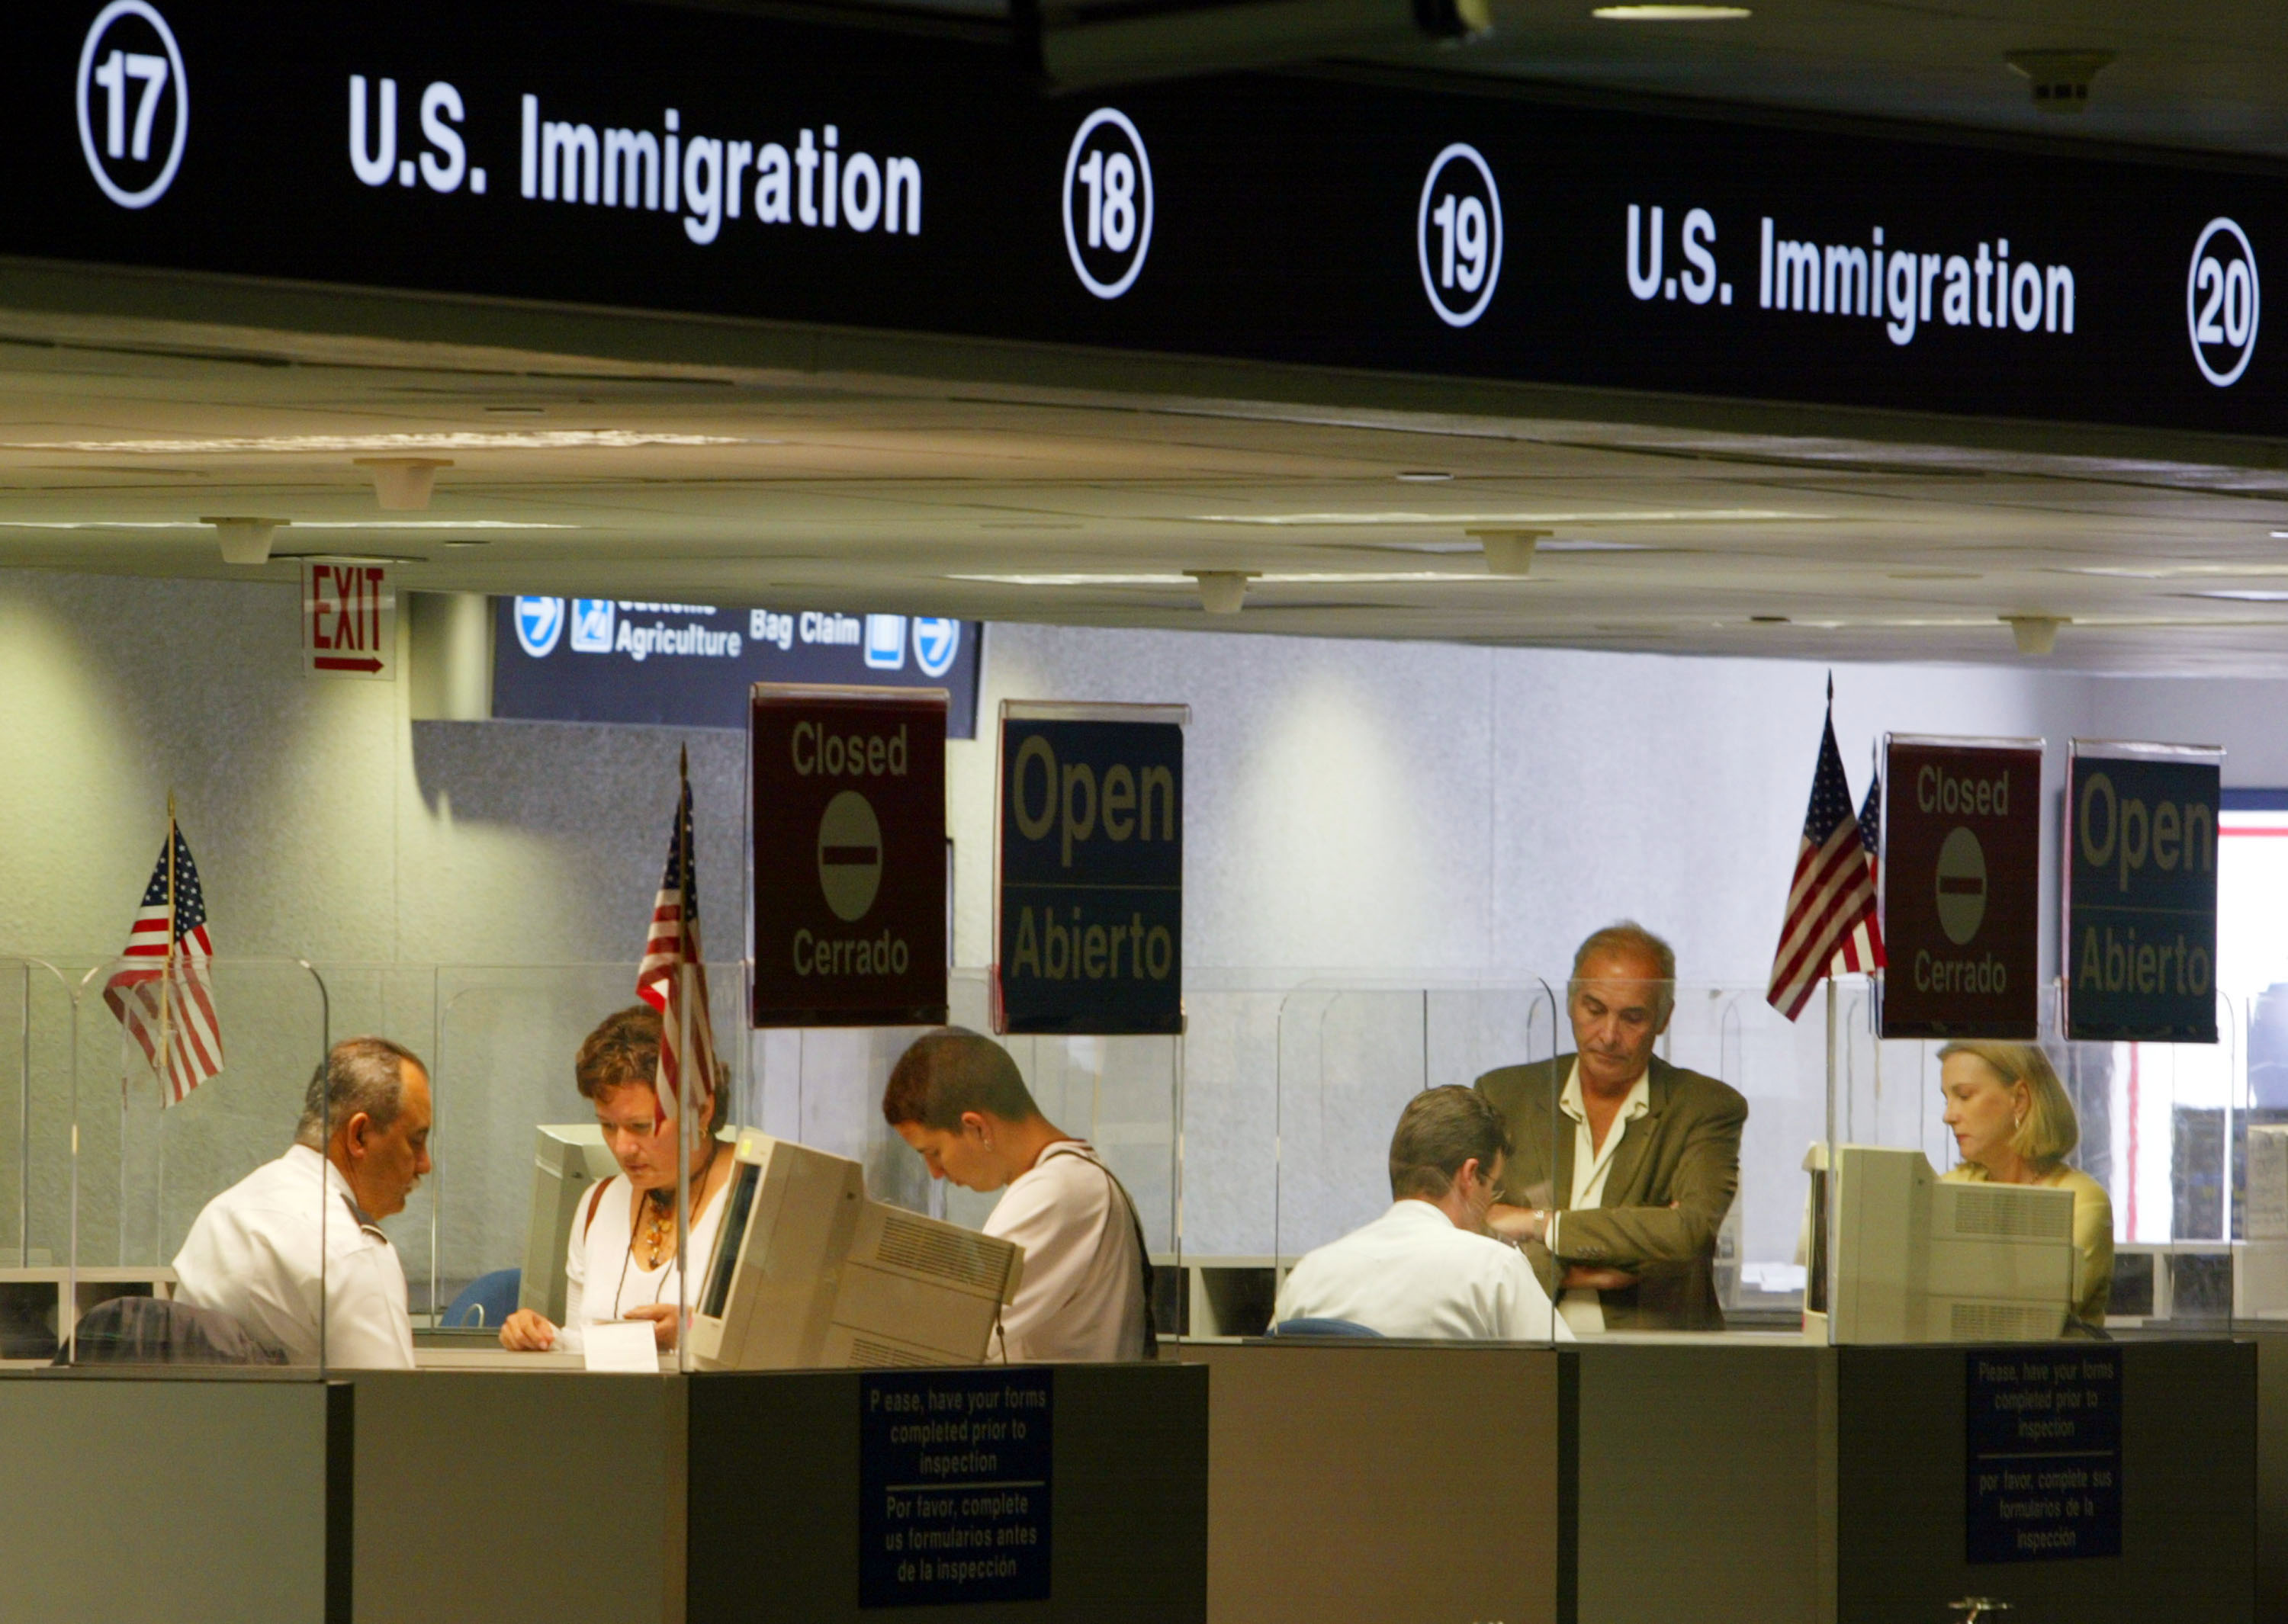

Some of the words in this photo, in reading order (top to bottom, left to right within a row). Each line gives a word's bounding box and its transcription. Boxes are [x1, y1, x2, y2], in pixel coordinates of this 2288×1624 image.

[95, 50, 168, 161] 17
[349, 74, 487, 195] U.S.
[520, 93, 921, 245] Immigration
[1079, 149, 1136, 252] 18
[1433, 194, 1488, 293] 19
[1627, 204, 1733, 306] U.S.
[1759, 217, 2075, 346] Immigration
[2196, 256, 2251, 348] 20
[313, 565, 384, 651] EXIT
[749, 608, 793, 650] Bag
[799, 611, 861, 645] Claim
[615, 619, 743, 662] Agriculture
[792, 721, 908, 776] Closed
[1012, 735, 1176, 868] Open
[1917, 763, 2010, 817] Closed
[2079, 772, 2212, 893] Open
[793, 928, 909, 977] Cerrado
[1011, 906, 1172, 981] Abierto
[2078, 926, 2211, 997] Abierto
[1914, 948, 2007, 993] Cerrado
[2023, 1362, 2049, 1382] have
[2053, 1364, 2078, 1385] your
[2083, 1359, 2114, 1380] forms
[870, 1389, 925, 1414] Pease,
[928, 1387, 962, 1410] have
[968, 1389, 999, 1414] your
[1005, 1386, 1046, 1408] forms
[1994, 1389, 2052, 1412] completed
[2056, 1389, 2081, 1411] prior
[2086, 1389, 2099, 1407] to
[890, 1419, 968, 1447] completed
[972, 1420, 1007, 1444] prior
[1012, 1419, 1027, 1439] to
[2018, 1416, 2075, 1441] inspection
[920, 1450, 998, 1478] inspection
[2038, 1468, 2088, 1493] complete
[2093, 1470, 2113, 1488] sus
[886, 1497, 911, 1519] Por
[917, 1495, 957, 1520] favor,
[962, 1492, 1029, 1520] complete
[2000, 1496, 2061, 1520] formularios
[2066, 1497, 2080, 1516] de
[2084, 1496, 2094, 1516] la
[908, 1525, 992, 1550] formularios
[997, 1525, 1037, 1546] antes
[898, 1559, 915, 1582] de
[920, 1558, 933, 1581] la
[937, 1554, 1017, 1584] inspección
